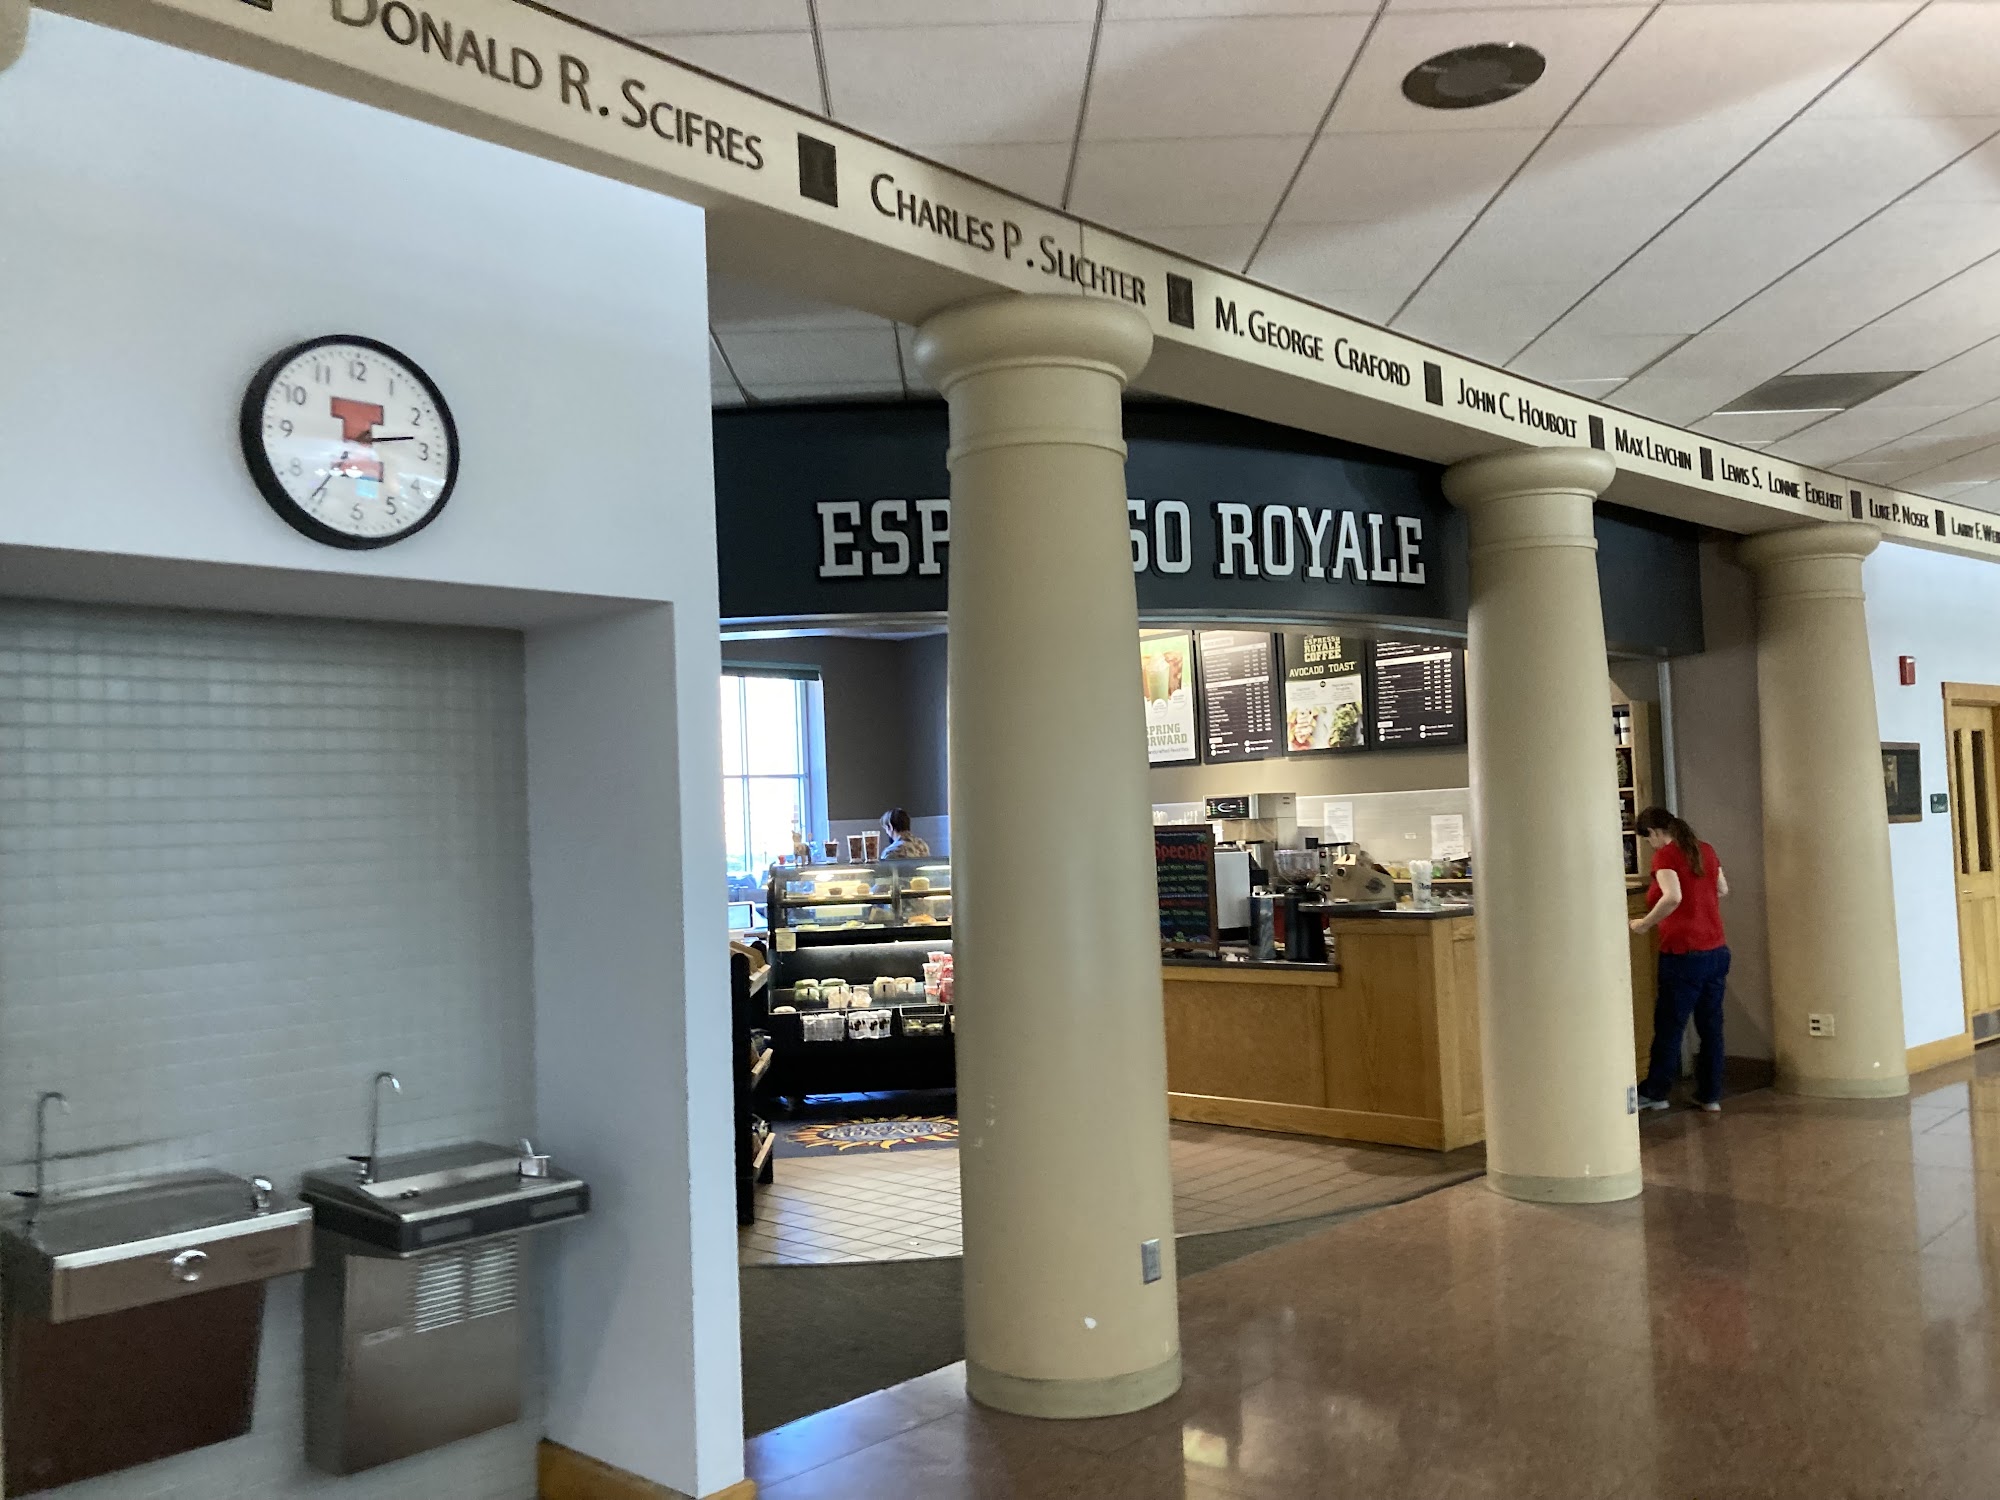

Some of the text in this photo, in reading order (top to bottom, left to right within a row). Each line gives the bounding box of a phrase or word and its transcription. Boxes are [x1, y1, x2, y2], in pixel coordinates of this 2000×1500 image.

[559, 54, 610, 117] R.
[621, 78, 765, 171] SCIFRES
[869, 173, 1147, 306] CHARLES P. SLICHTER
[1215, 296, 1411, 387] M. GEORGE CRAFORD
[350, 361, 367, 382] 12
[283, 384, 307, 406] 10
[388, 379, 395, 396] 1
[411, 407, 421, 426] 2
[1457, 377, 1496, 415] JOHN
[1518, 397, 1577, 439] HOUBOLT
[279, 419, 294, 438] 9
[418, 442, 429, 461] 3
[1615, 427, 1692, 471] MAX LEVCHIN
[1720, 457, 1750, 486] LEWIS
[1751, 466, 1763, 490] S.
[1768, 471, 1801, 500] LONNIE
[350, 502, 364, 520] 6
[384, 496, 397, 515] 5
[1869, 498, 1930, 529] LUKE P. NOSEK
[816, 498, 1426, 585] ESPSO ROYALE
[1303, 640, 1341, 654] ROYALE
[1304, 649, 1342, 663] COFFEE
[1289, 661, 1355, 678] AVOCADO TOAST
[1147, 733, 1188, 747] RWARD
